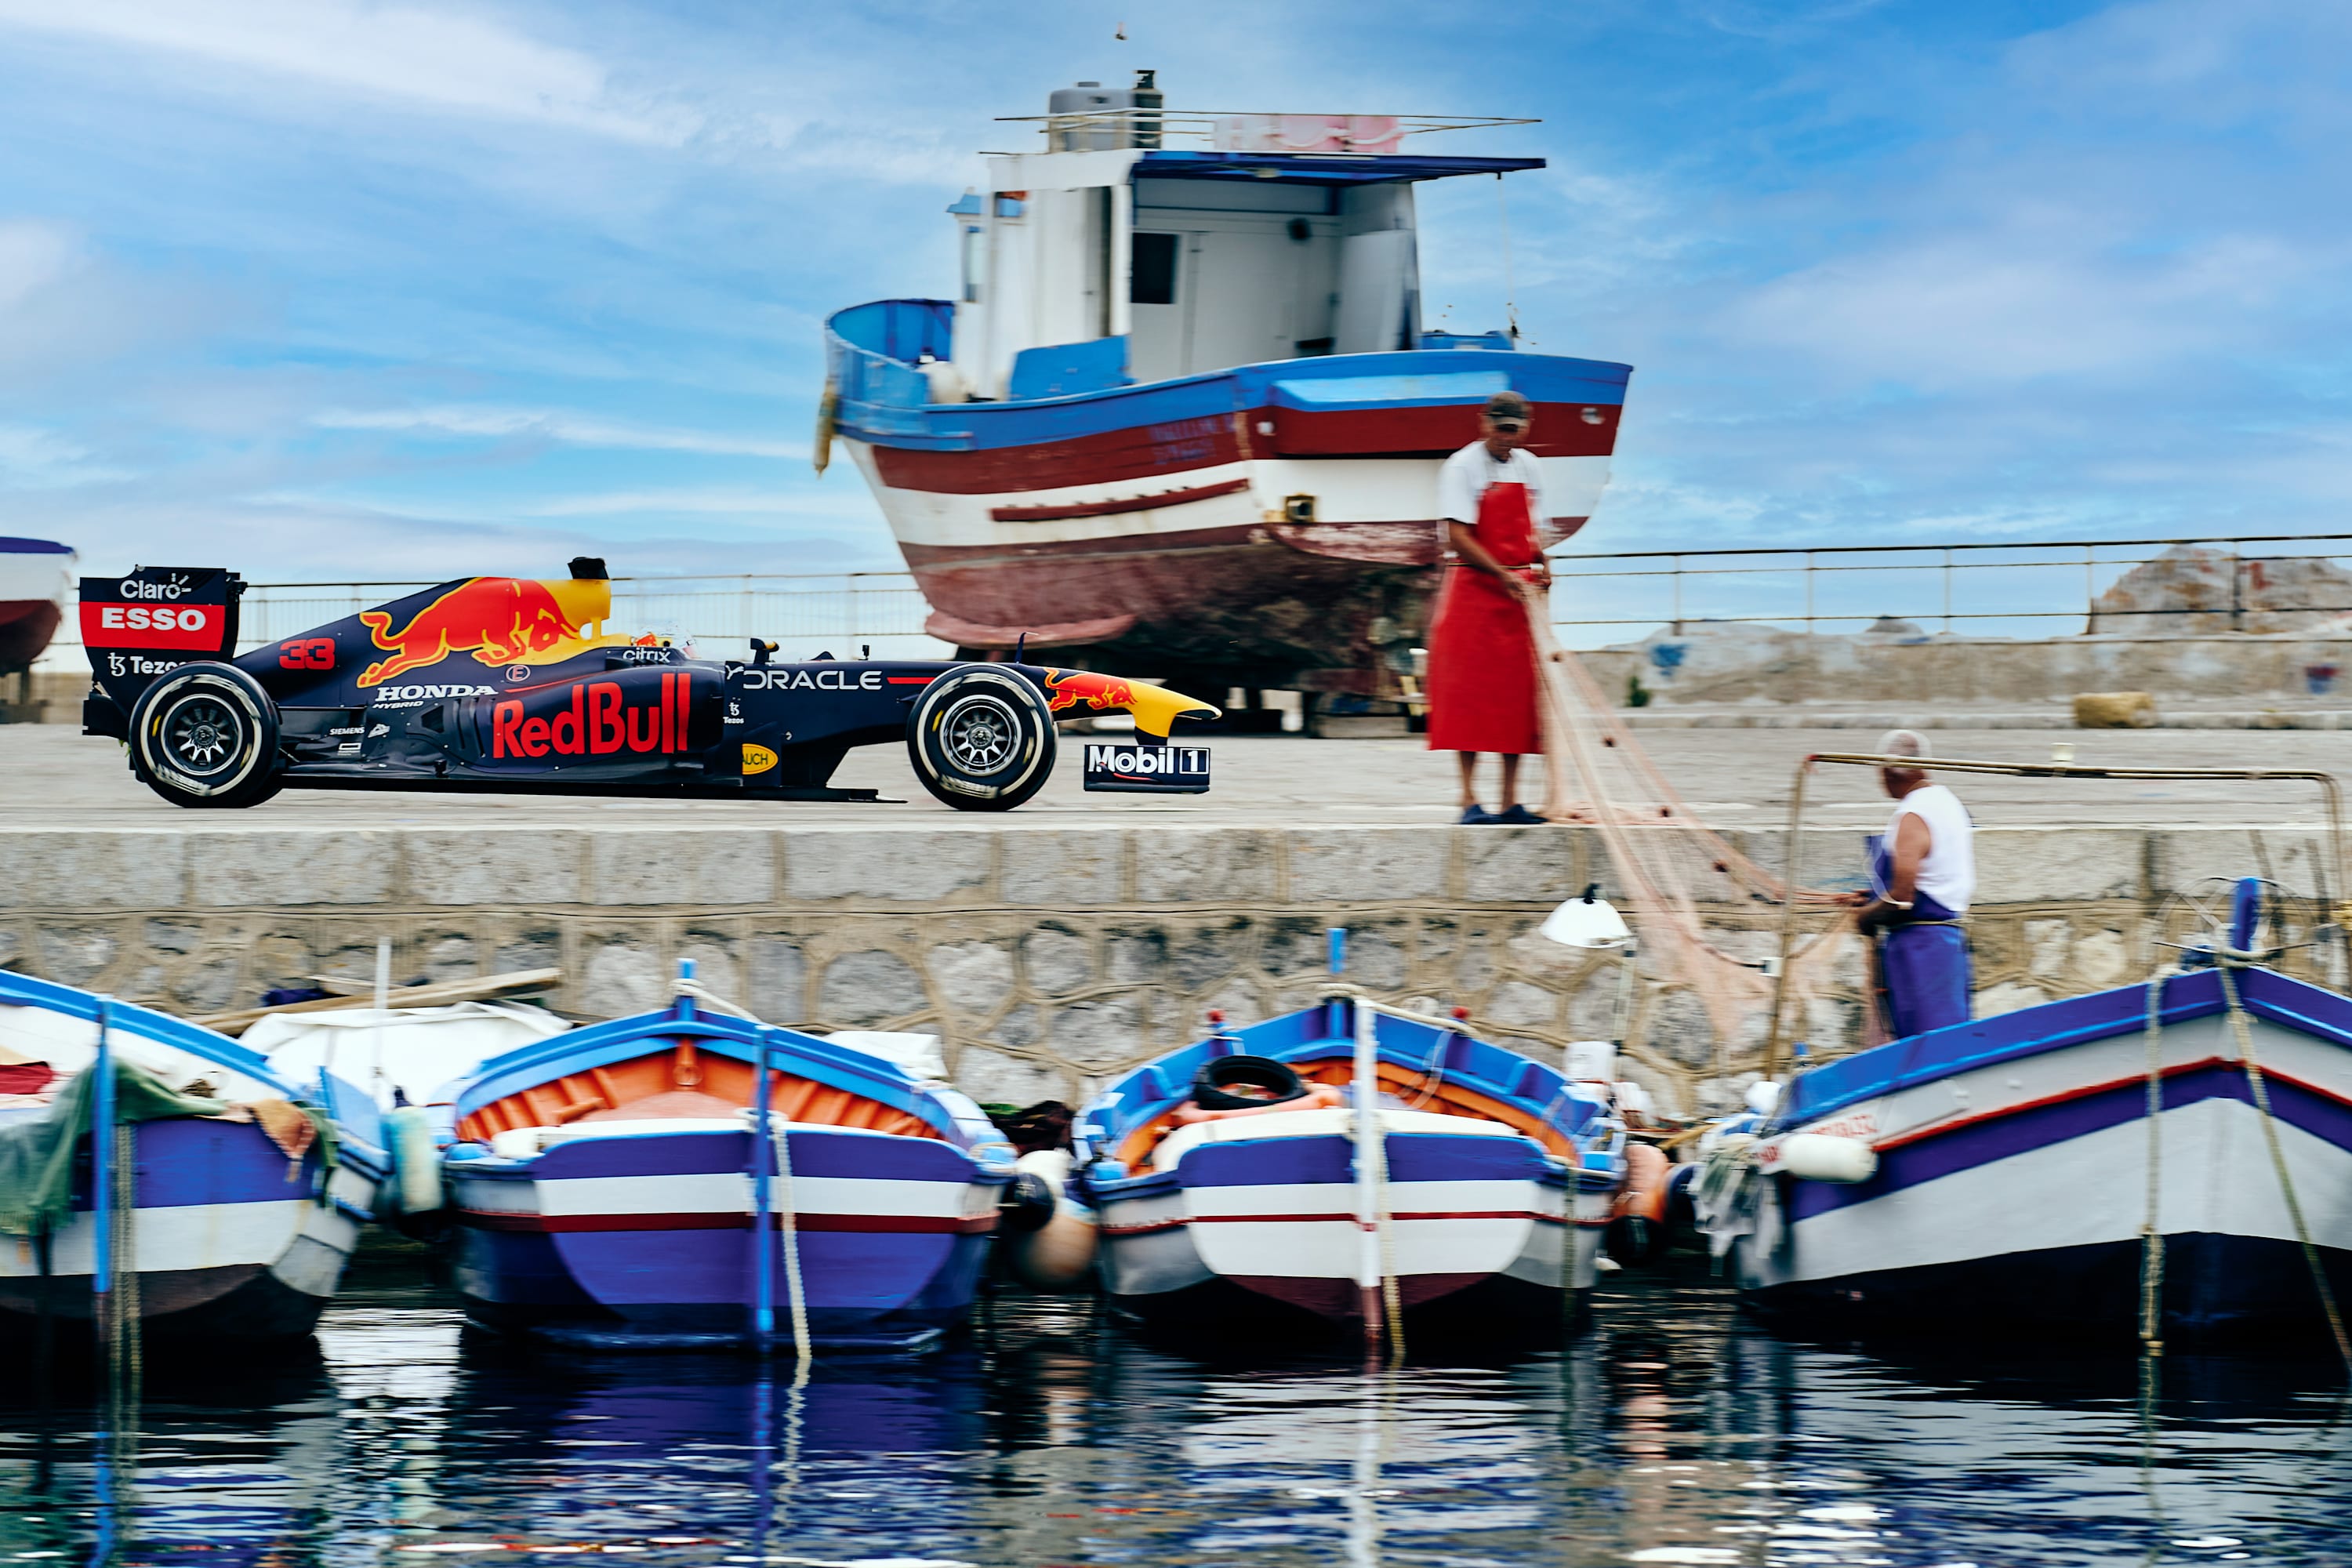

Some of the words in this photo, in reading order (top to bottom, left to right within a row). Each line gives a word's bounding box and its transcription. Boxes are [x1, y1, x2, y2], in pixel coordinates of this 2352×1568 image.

[120, 579, 181, 601] Claro
[102, 607, 206, 631] ESSO
[279, 637, 336, 670] 33
[129, 655, 187, 674] Tezo
[375, 684, 499, 702] HONDA
[372, 700, 424, 709] HYBRID
[329, 726, 365, 735] SIEMENS
[1087, 745, 1175, 775] Mobil
[1187, 750, 1196, 772] 1
